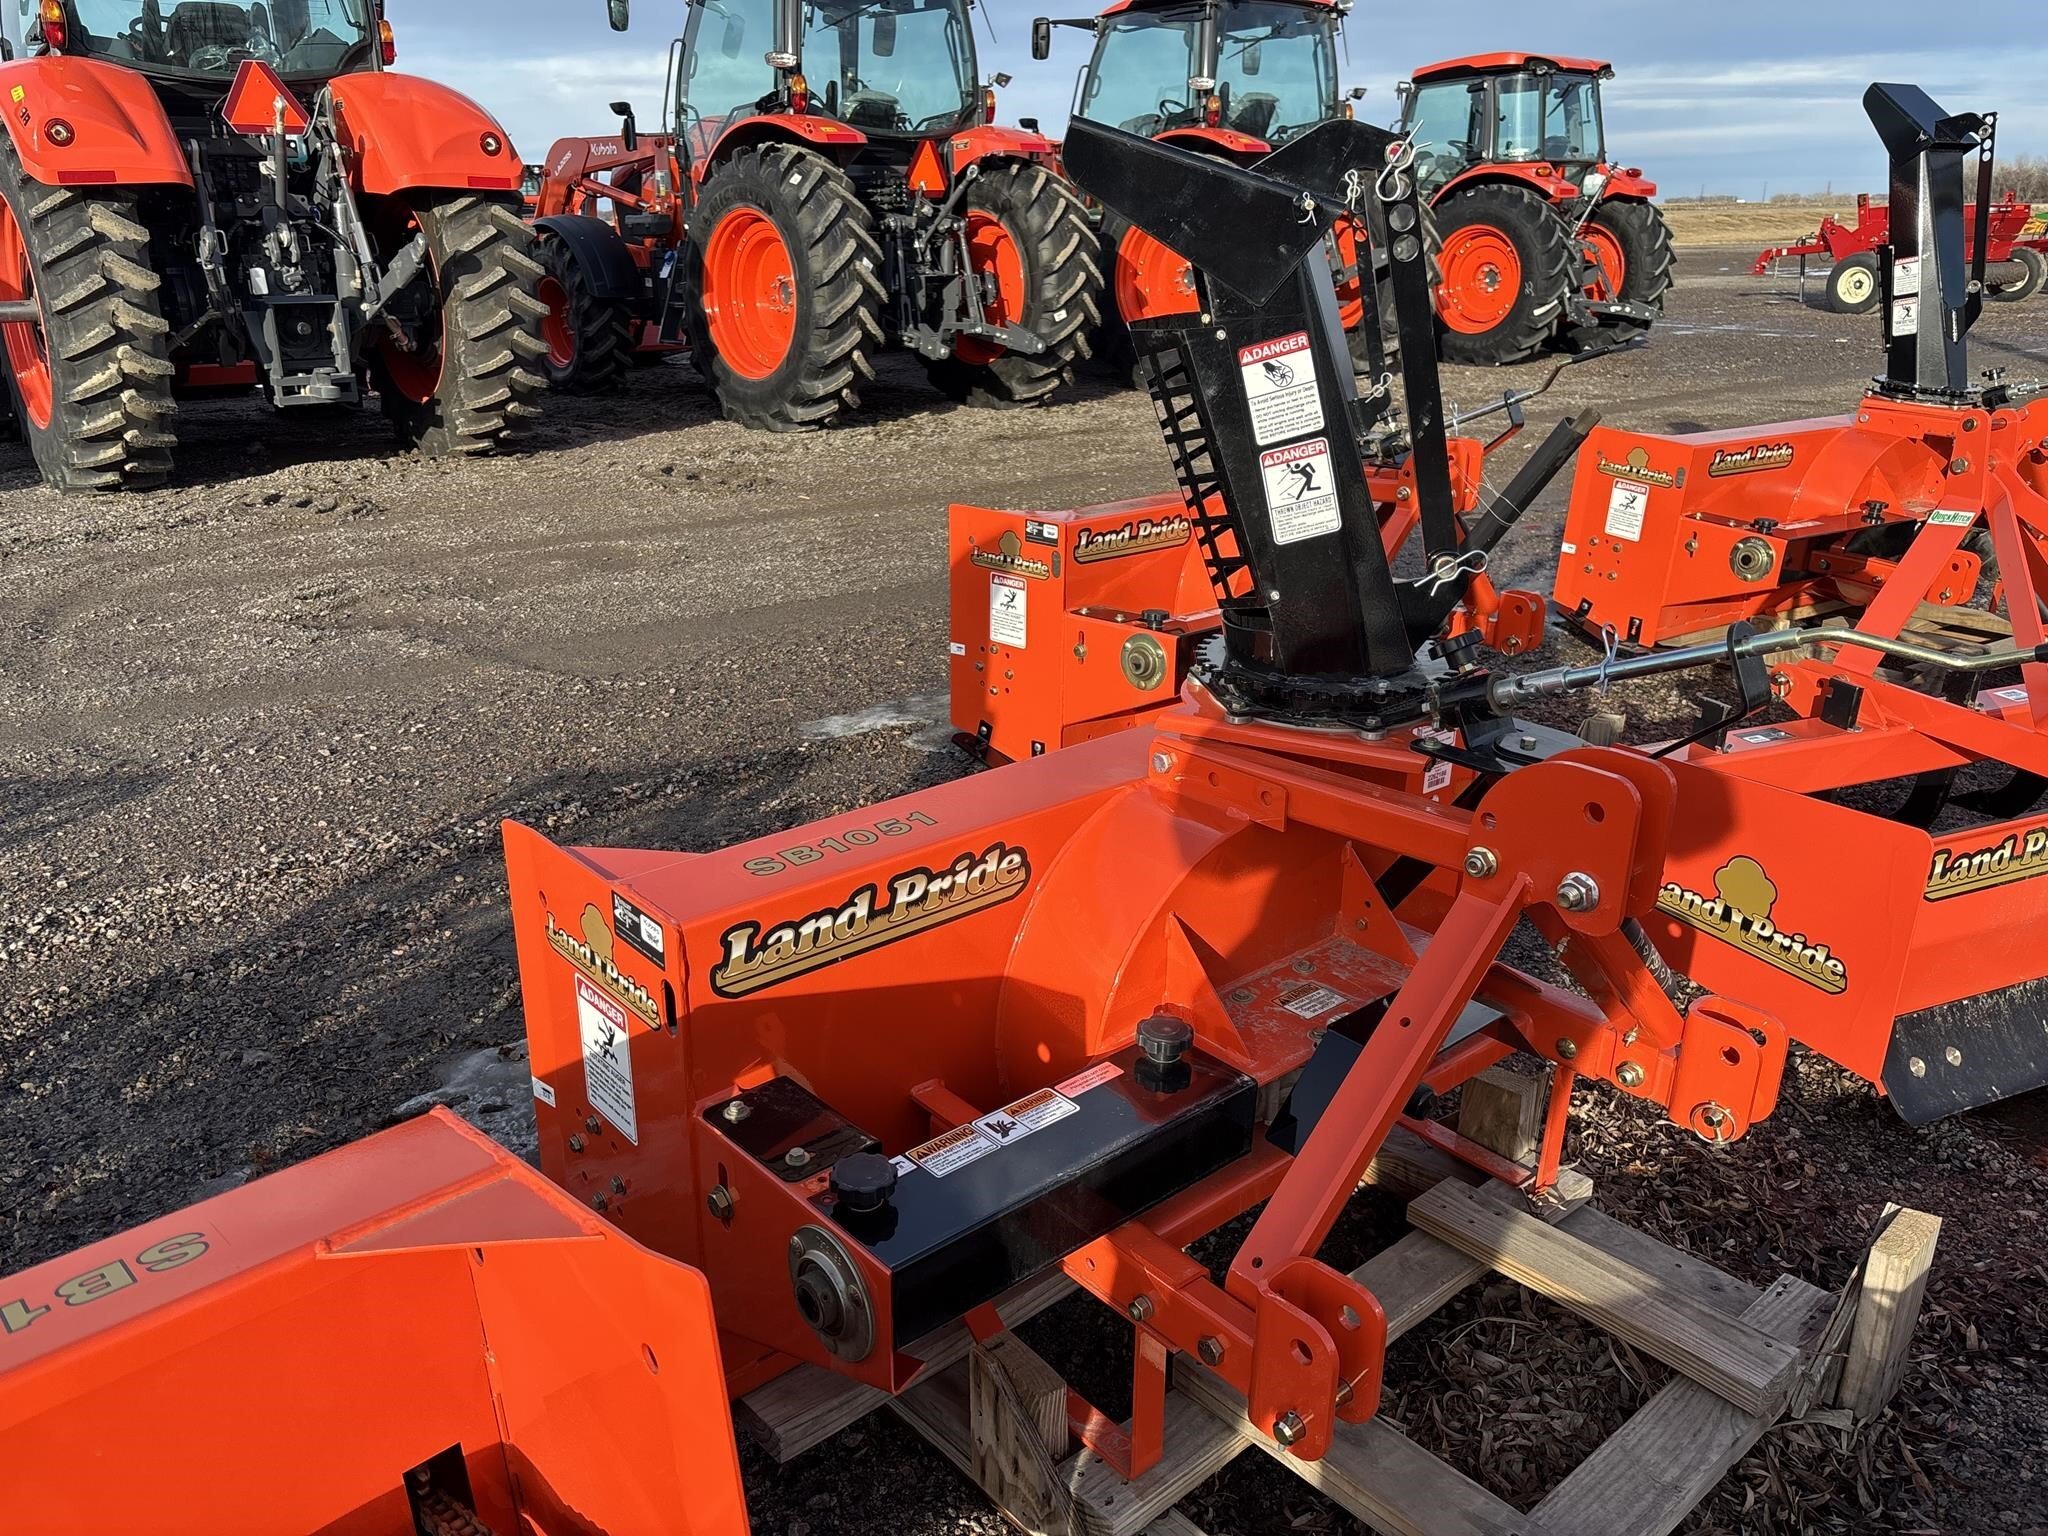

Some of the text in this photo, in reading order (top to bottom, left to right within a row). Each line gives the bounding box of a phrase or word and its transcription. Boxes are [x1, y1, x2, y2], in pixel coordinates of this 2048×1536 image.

[590, 142, 617, 156] Kubota
[1252, 335, 1308, 360] DANGER
[1273, 443, 1325, 464] DANGER
[1713, 443, 1793, 469] Land Pride
[1600, 457, 1673, 485] Land Pride
[1274, 495, 1332, 516] THROWN OBJECT HAZARD
[1079, 525, 1132, 554] Land
[1136, 517, 1189, 545] Pride
[973, 546, 1049, 575] Land Pride
[999, 577, 1024, 589] DANGER
[743, 811, 938, 877] SB1051
[1927, 839, 2015, 887] Land
[721, 889, 873, 979] Land
[887, 848, 1023, 923] Pride
[1658, 884, 1846, 982] and Pride
[545, 911, 594, 970] Land
[602, 956, 659, 1020] Pride
[588, 988, 625, 1028] DANGER
[1019, 1090, 1054, 1112] WARNING
[923, 1127, 974, 1156] WARNING
[0, 1232, 210, 1334] SB1
